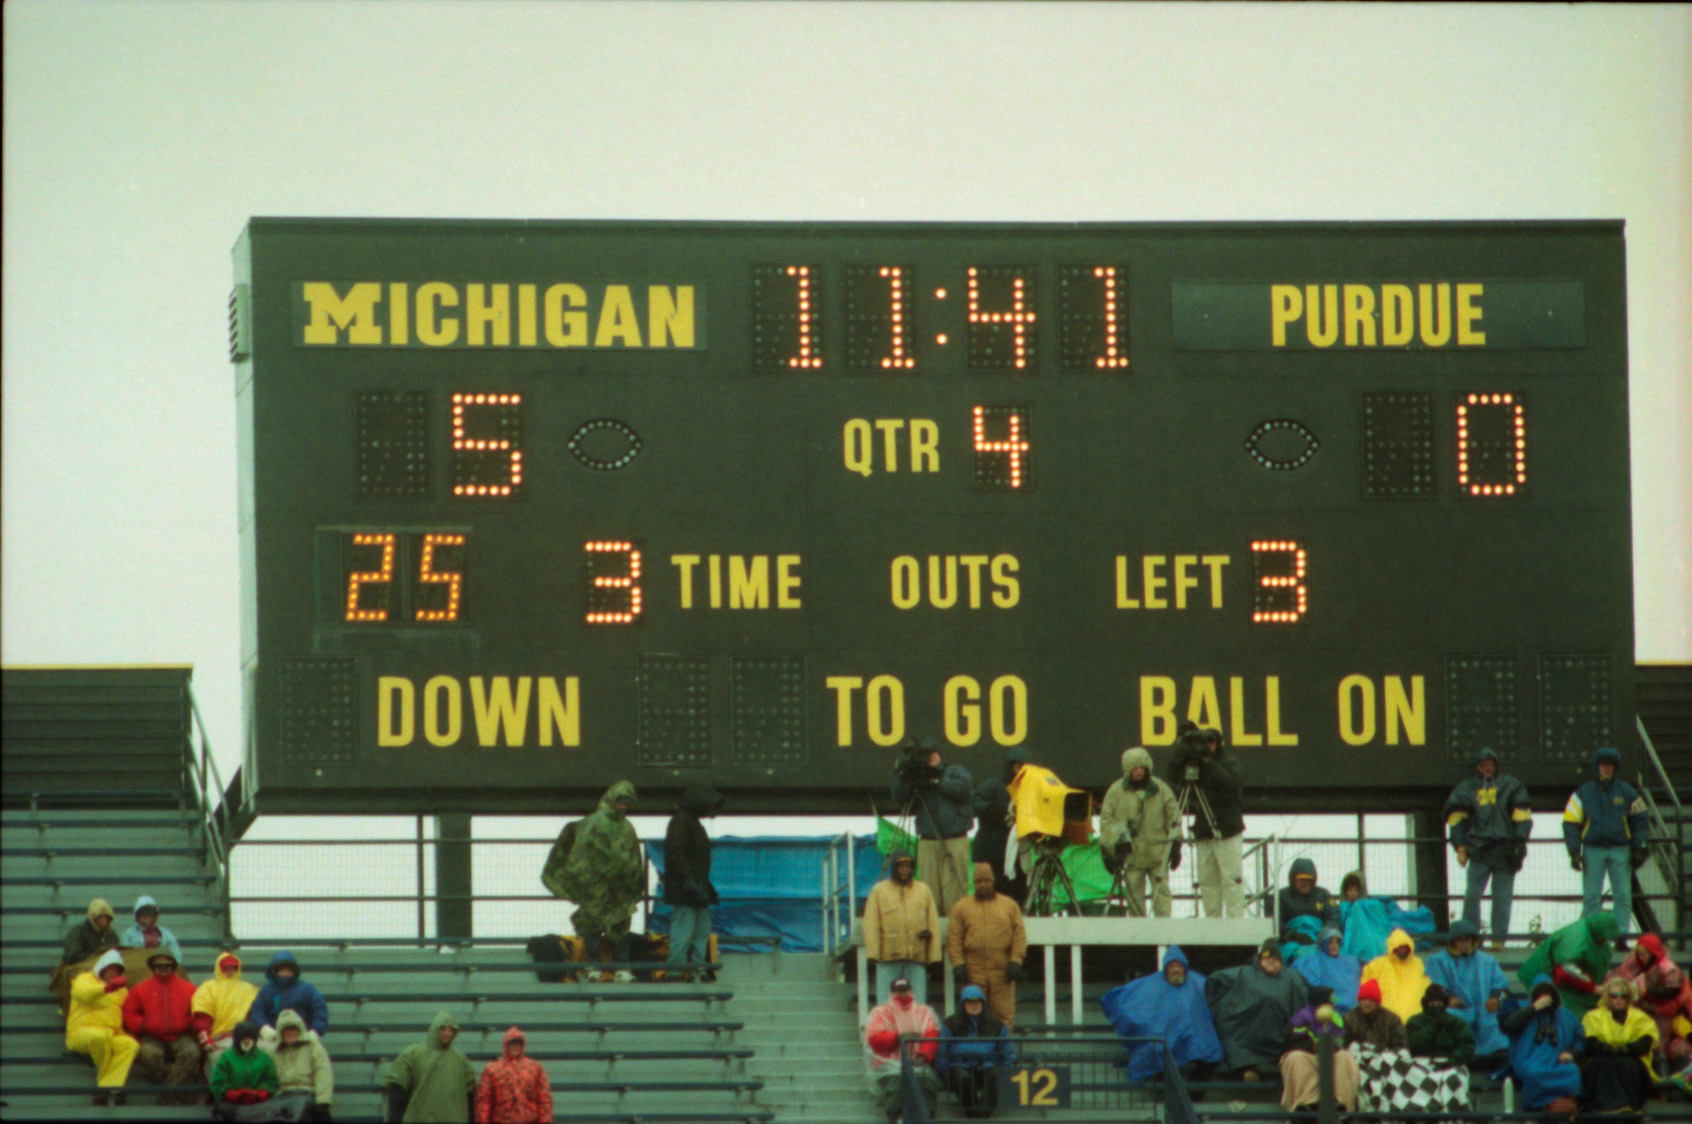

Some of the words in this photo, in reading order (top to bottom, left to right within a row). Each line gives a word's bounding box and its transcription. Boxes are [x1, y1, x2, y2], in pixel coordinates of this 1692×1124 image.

[303, 281, 696, 348] MICHIGAN
[785, 265, 1129, 370] 11:41
[1270, 282, 1486, 348] PURDUE
[451, 392, 523, 497] 5
[842, 417, 940, 477] QTR
[971, 404, 1031, 490] 4
[1455, 392, 1527, 497] 0
[345, 532, 465, 622] 25
[583, 539, 643, 624] 3
[670, 553, 802, 610] TIME
[890, 553, 1021, 610] OUTS
[1115, 554, 1231, 610] LEFT
[1250, 539, 1308, 624] 3
[377, 674, 581, 748] DOWN
[825, 674, 906, 747] TO
[943, 674, 1028, 747] GO
[1139, 675, 1299, 746] BALL
[1337, 673, 1426, 746] ON
[1011, 1068, 1058, 1106] 12
